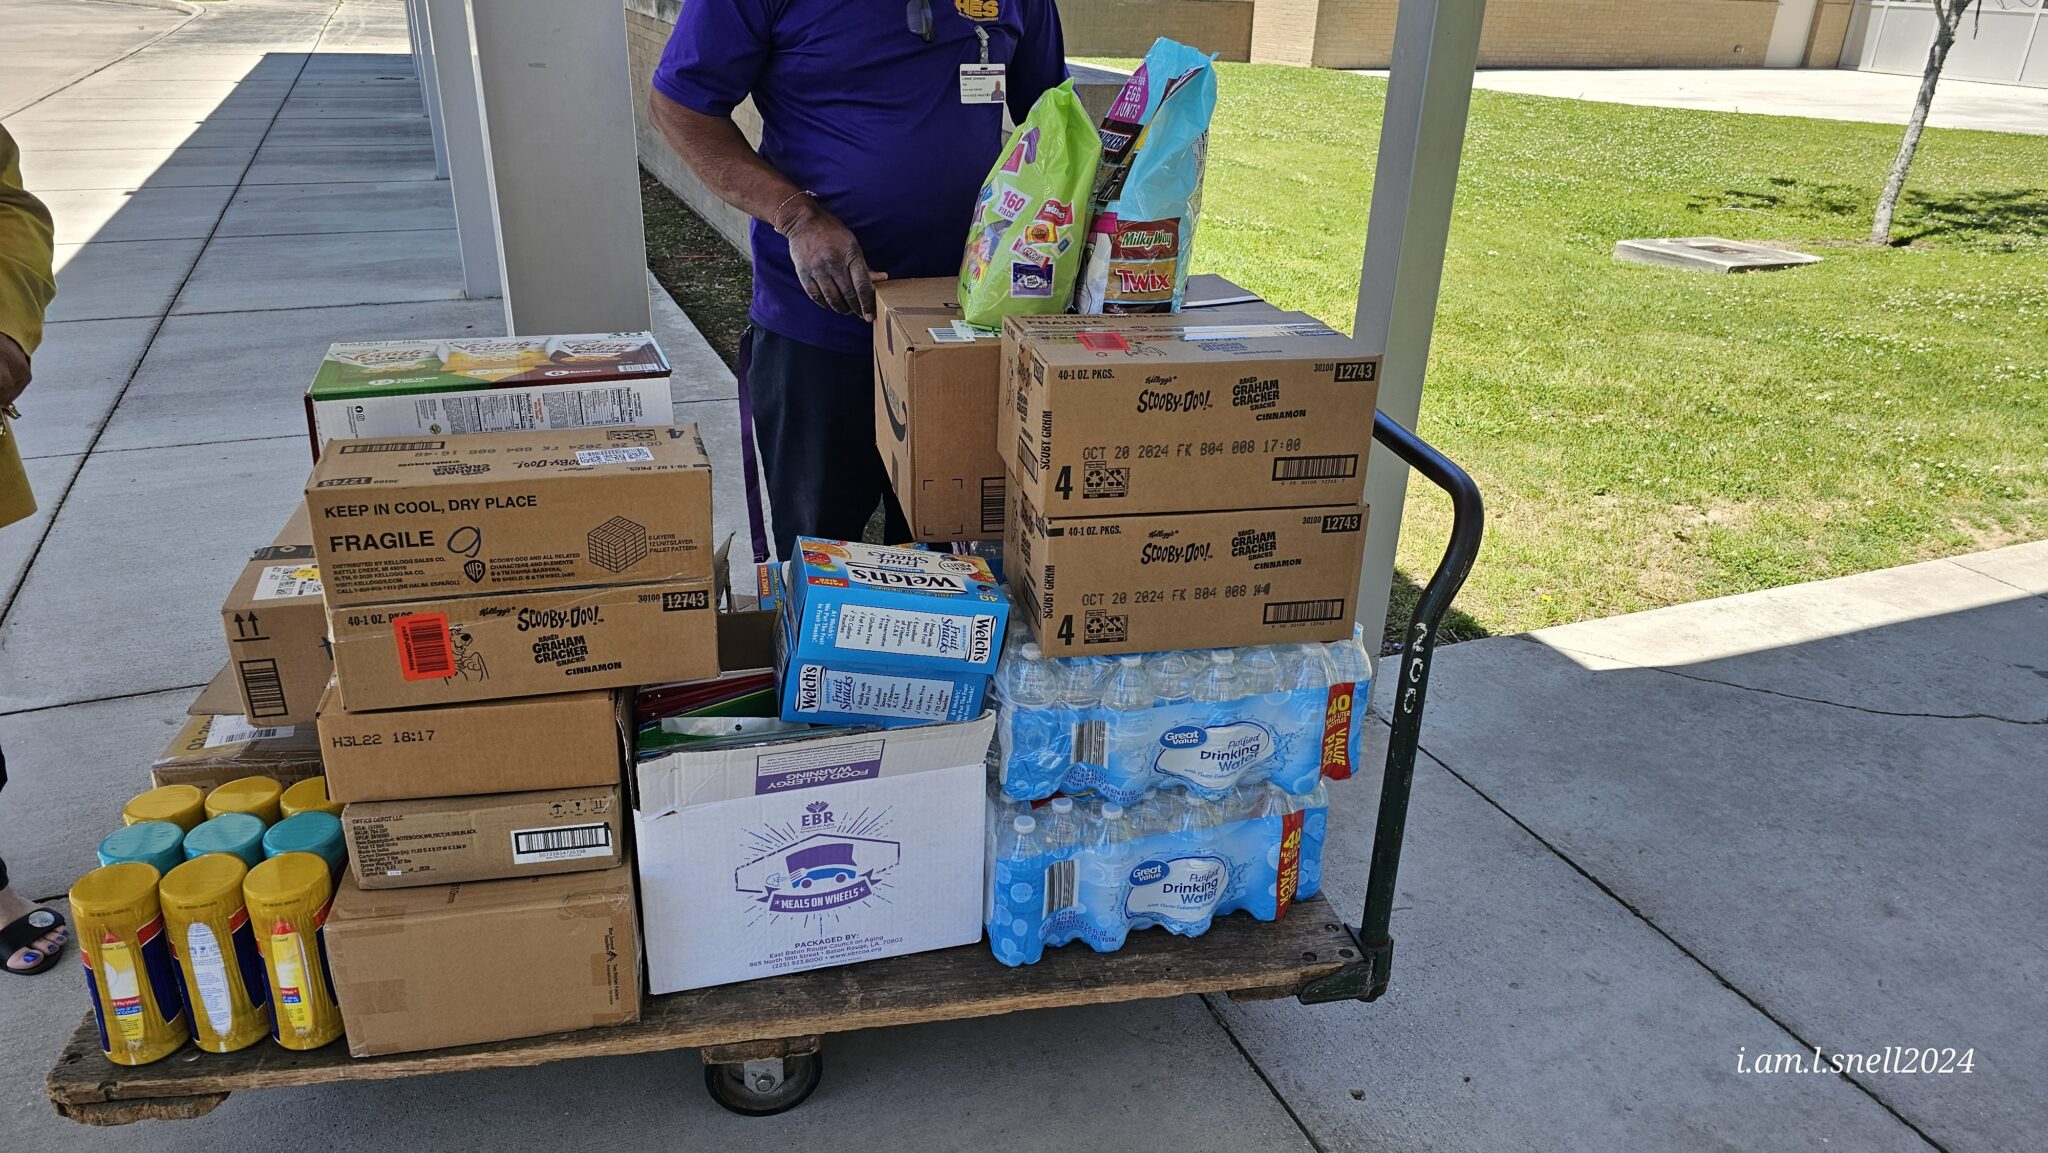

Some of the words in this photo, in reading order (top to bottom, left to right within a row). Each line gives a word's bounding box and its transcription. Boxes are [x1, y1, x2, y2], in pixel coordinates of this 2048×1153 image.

[1125, 86, 1141, 102] EGG
[1003, 191, 1026, 212] 160
[1058, 370, 1077, 380] 40-1
[1077, 370, 1090, 380] OZ.
[1091, 368, 1115, 380] PKGS.
[1313, 363, 1334, 372] 30100
[1338, 364, 1372, 379] 12743
[1232, 379, 1279, 397] GRAHAM
[1137, 388, 1211, 413] SCOOBY-DOO!
[1232, 389, 1280, 407] CRACKER
[1041, 410, 1053, 438] GRHM
[1256, 410, 1306, 421] CINNAMON
[1083, 447, 1107, 460] OCT
[1114, 446, 1130, 459] 20
[1138, 445, 1169, 458] 2024
[1177, 444, 1192, 457] FK
[1263, 438, 1302, 453] 17:00
[1054, 466, 1073, 499] 4
[325, 504, 369, 518] KEEP
[374, 504, 390, 516] IN
[395, 501, 445, 514] COOL,
[449, 499, 480, 511] DRY
[485, 495, 537, 509] PLACE
[1068, 526, 1085, 536] 40-1
[1086, 526, 1098, 536] OZ.
[1100, 525, 1122, 535] PKGS.
[1302, 516, 1322, 525] 30100
[1325, 515, 1359, 531] 12743
[329, 530, 435, 552] FRAGILE
[1231, 532, 1276, 547] GRAHAM
[866, 551, 928, 563] Snacks
[1141, 542, 1212, 565] SCOOBY-DOO!
[1231, 541, 1277, 557] CRACKER
[879, 559, 918, 568] Fruit
[1254, 558, 1302, 570] CINNAMON
[852, 569, 960, 588] Welch's
[638, 594, 660, 604] 30100
[665, 592, 706, 610] 12743
[1082, 593, 1105, 606] OCT
[1112, 592, 1127, 605] 20
[1135, 590, 1164, 603] 2024
[1172, 589, 1186, 601] FK
[348, 615, 369, 626] 40-1
[371, 614, 386, 624] OZ.
[517, 606, 599, 632] SCOOBY-DOO!
[940, 617, 953, 654] Snacks
[950, 626, 960, 650] Fruit
[1057, 614, 1074, 645] 4
[532, 635, 586, 654] GRAHAM
[973, 617, 990, 662] Welch's
[534, 646, 589, 664] CRACKER
[564, 661, 622, 676] CINNAMON
[801, 666, 817, 710] Welch's
[832, 678, 843, 703] Fruit
[840, 675, 853, 710] Snacks
[1328, 694, 1351, 716] 40
[1337, 710, 1351, 719] LITER
[332, 733, 383, 748] H3L22
[392, 730, 435, 744] 18:17
[1164, 730, 1199, 741] Great
[1228, 732, 1261, 749] Purified
[1200, 743, 1260, 760] Drinking
[1322, 733, 1336, 769] PACK
[1333, 727, 1347, 766] VALUE
[1218, 751, 1259, 772] Water
[768, 775, 828, 789] ALLERGY
[786, 766, 852, 780] WARNING
[831, 768, 868, 779] FOOD
[801, 812, 835, 827] EBR
[1283, 827, 1301, 848] 40
[1133, 865, 1162, 878] Great
[1139, 872, 1161, 881] Value
[1190, 865, 1220, 882] Purified
[1163, 878, 1218, 893] Drinking
[1280, 868, 1291, 906] PACK
[781, 899, 810, 909] MEALS
[811, 898, 824, 906] ON
[825, 888, 859, 904] WHEELS
[1180, 888, 1217, 904] Water
[785, 948, 805, 956] Baton
[806, 946, 827, 954] Rouge
[829, 942, 853, 950] Council
[864, 935, 884, 943] Aging
[794, 935, 842, 949] PACKAGED
[763, 957, 783, 965] North
[799, 951, 820, 959] Street
[826, 947, 845, 955] Baton
